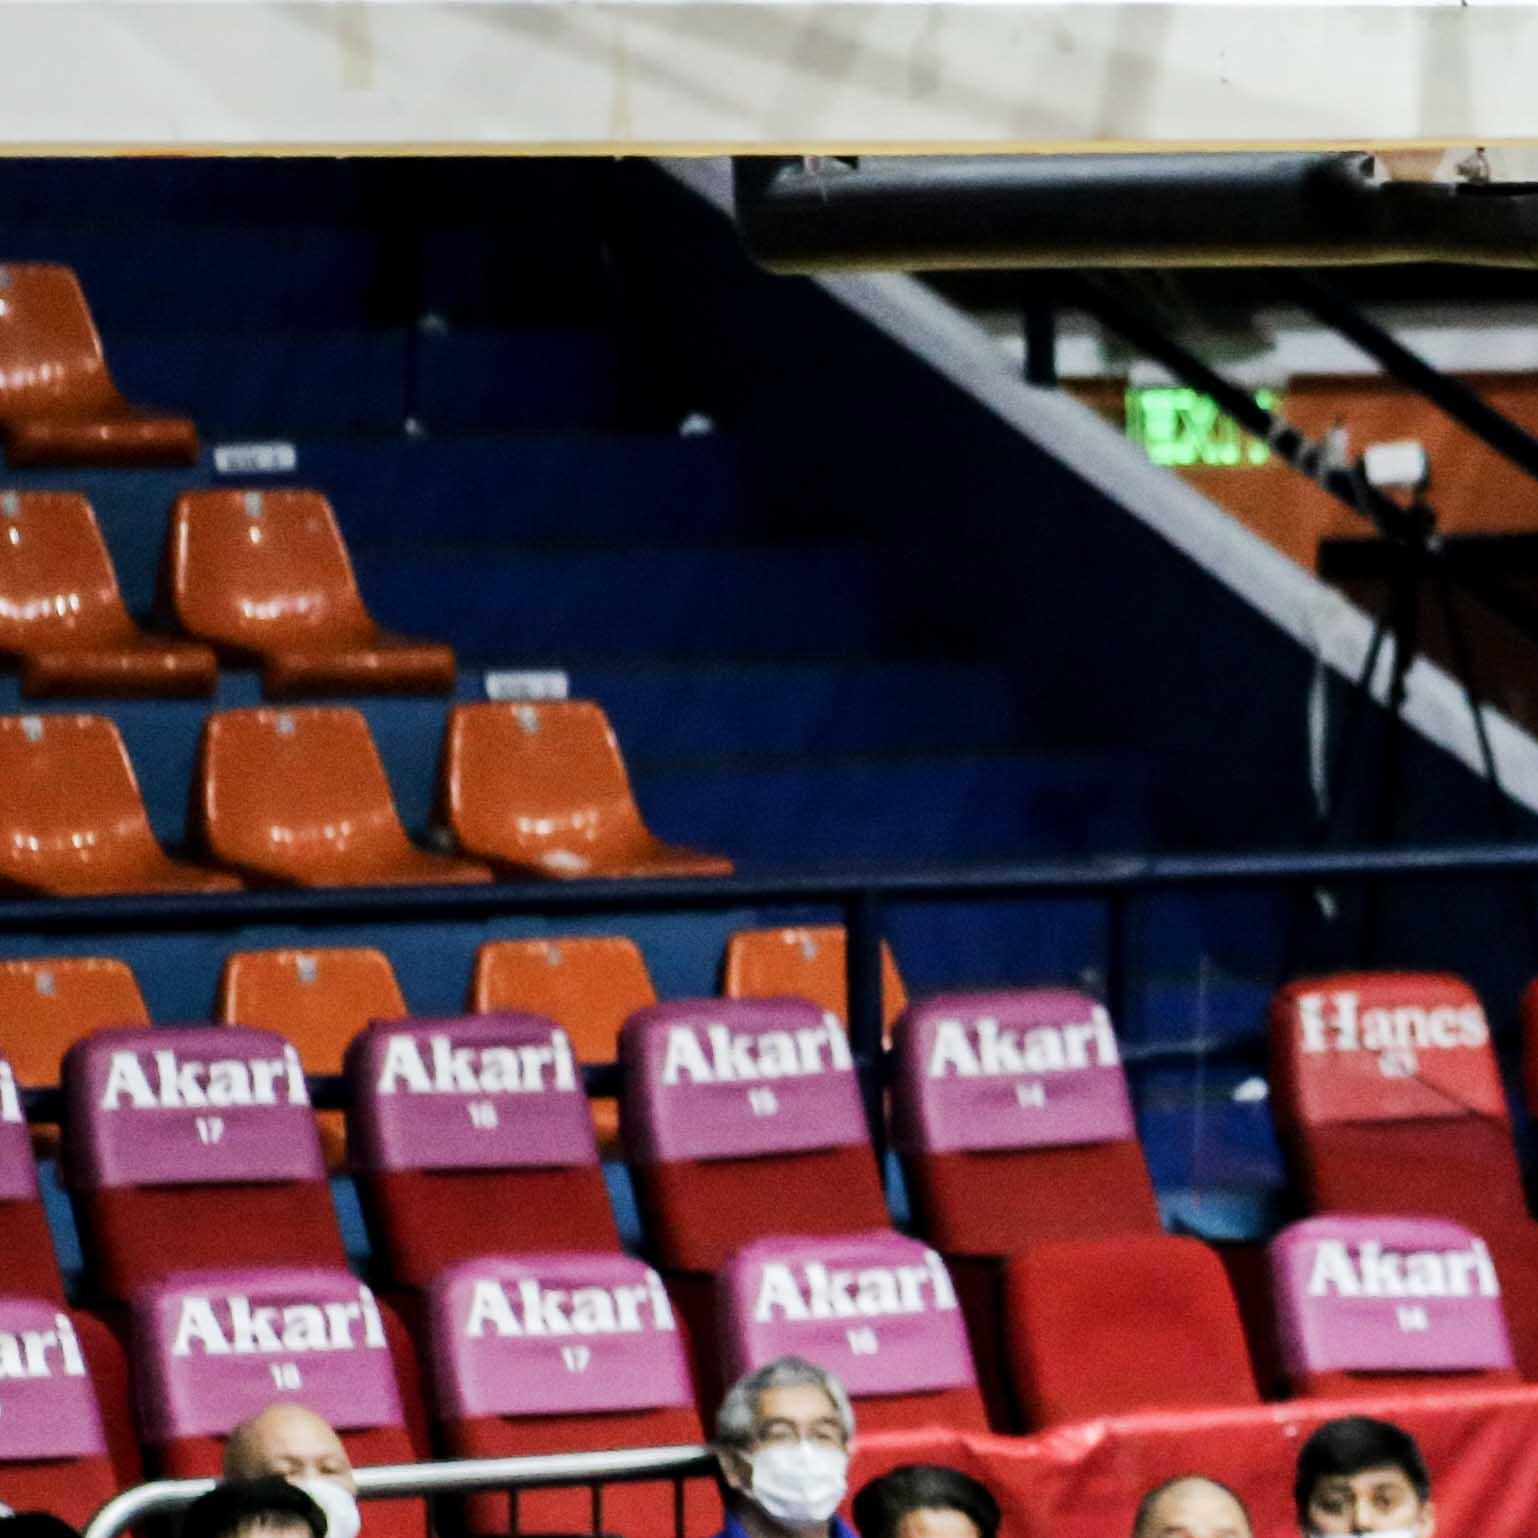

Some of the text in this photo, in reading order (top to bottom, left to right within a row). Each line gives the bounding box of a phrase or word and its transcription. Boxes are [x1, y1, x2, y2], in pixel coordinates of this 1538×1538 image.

[662, 1012, 853, 1086] Akari
[928, 1002, 1121, 1079] Akari
[1297, 990, 1490, 1054] Hanes
[103, 1043, 311, 1112] Akari
[378, 1029, 578, 1096] Akari
[754, 1250, 958, 1324] Akari
[1305, 1236, 1500, 1298] Akari
[172, 1283, 388, 1357] Akari
[466, 1268, 676, 1339] Akari
